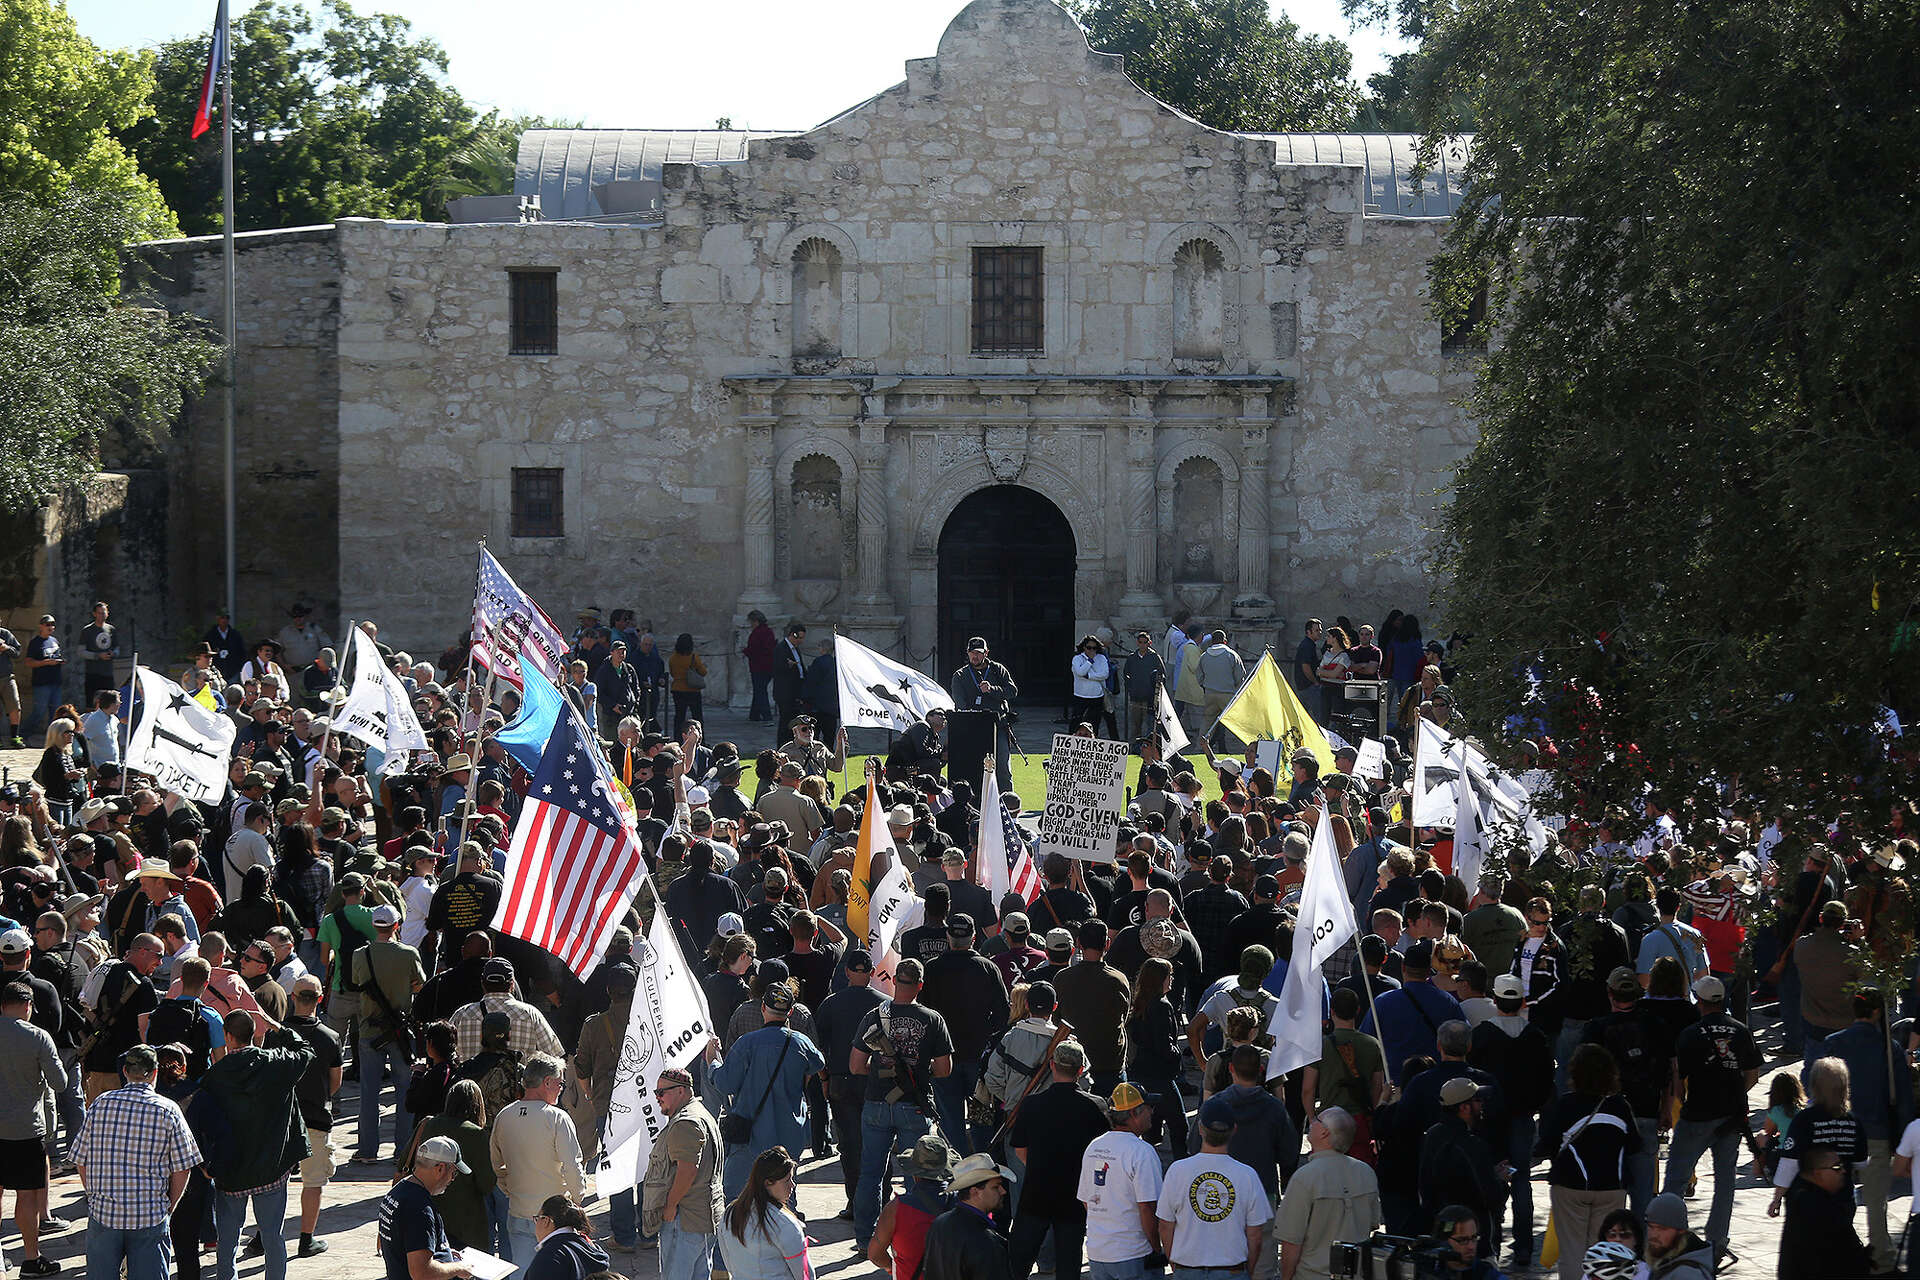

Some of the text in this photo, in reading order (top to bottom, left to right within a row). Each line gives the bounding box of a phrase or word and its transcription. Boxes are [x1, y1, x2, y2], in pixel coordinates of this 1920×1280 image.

[533, 632, 544, 645] OR
[859, 707, 889, 719] COME
[369, 723, 389, 740] TRE
[1055, 737, 1128, 755] 176 YEARS AGO
[1052, 756, 1070, 764] RUNS
[1093, 761, 1113, 770] VEINS
[1053, 748, 1118, 763] MEN WHOSE BLOOD
[1049, 771, 1074, 781] BATTLE
[1077, 774, 1108, 785] AGAINST
[1050, 763, 1068, 772] GAVE
[1070, 765, 1090, 775] THEIR
[1092, 769, 1111, 778] LIVES
[194, 782, 210, 799] IT
[1053, 786, 1107, 801] THEY DARED TO
[1047, 793, 1098, 808] UPHOLD THEIR
[1047, 803, 1119, 826] GOD-GIVEN
[1441, 816, 1456, 826] CO
[1044, 816, 1110, 832] RIGHT AND DUTY
[1044, 824, 1053, 832] TO
[1055, 825, 1072, 835] BARE
[1073, 829, 1094, 838] ARMS
[1041, 833, 1058, 844] SO
[1061, 835, 1088, 849] WILL
[877, 970, 891, 982] IT
[647, 976, 664, 1036] CULPEPER
[636, 1074, 659, 1144] OR DEA
[600, 1144, 611, 1171] ME
